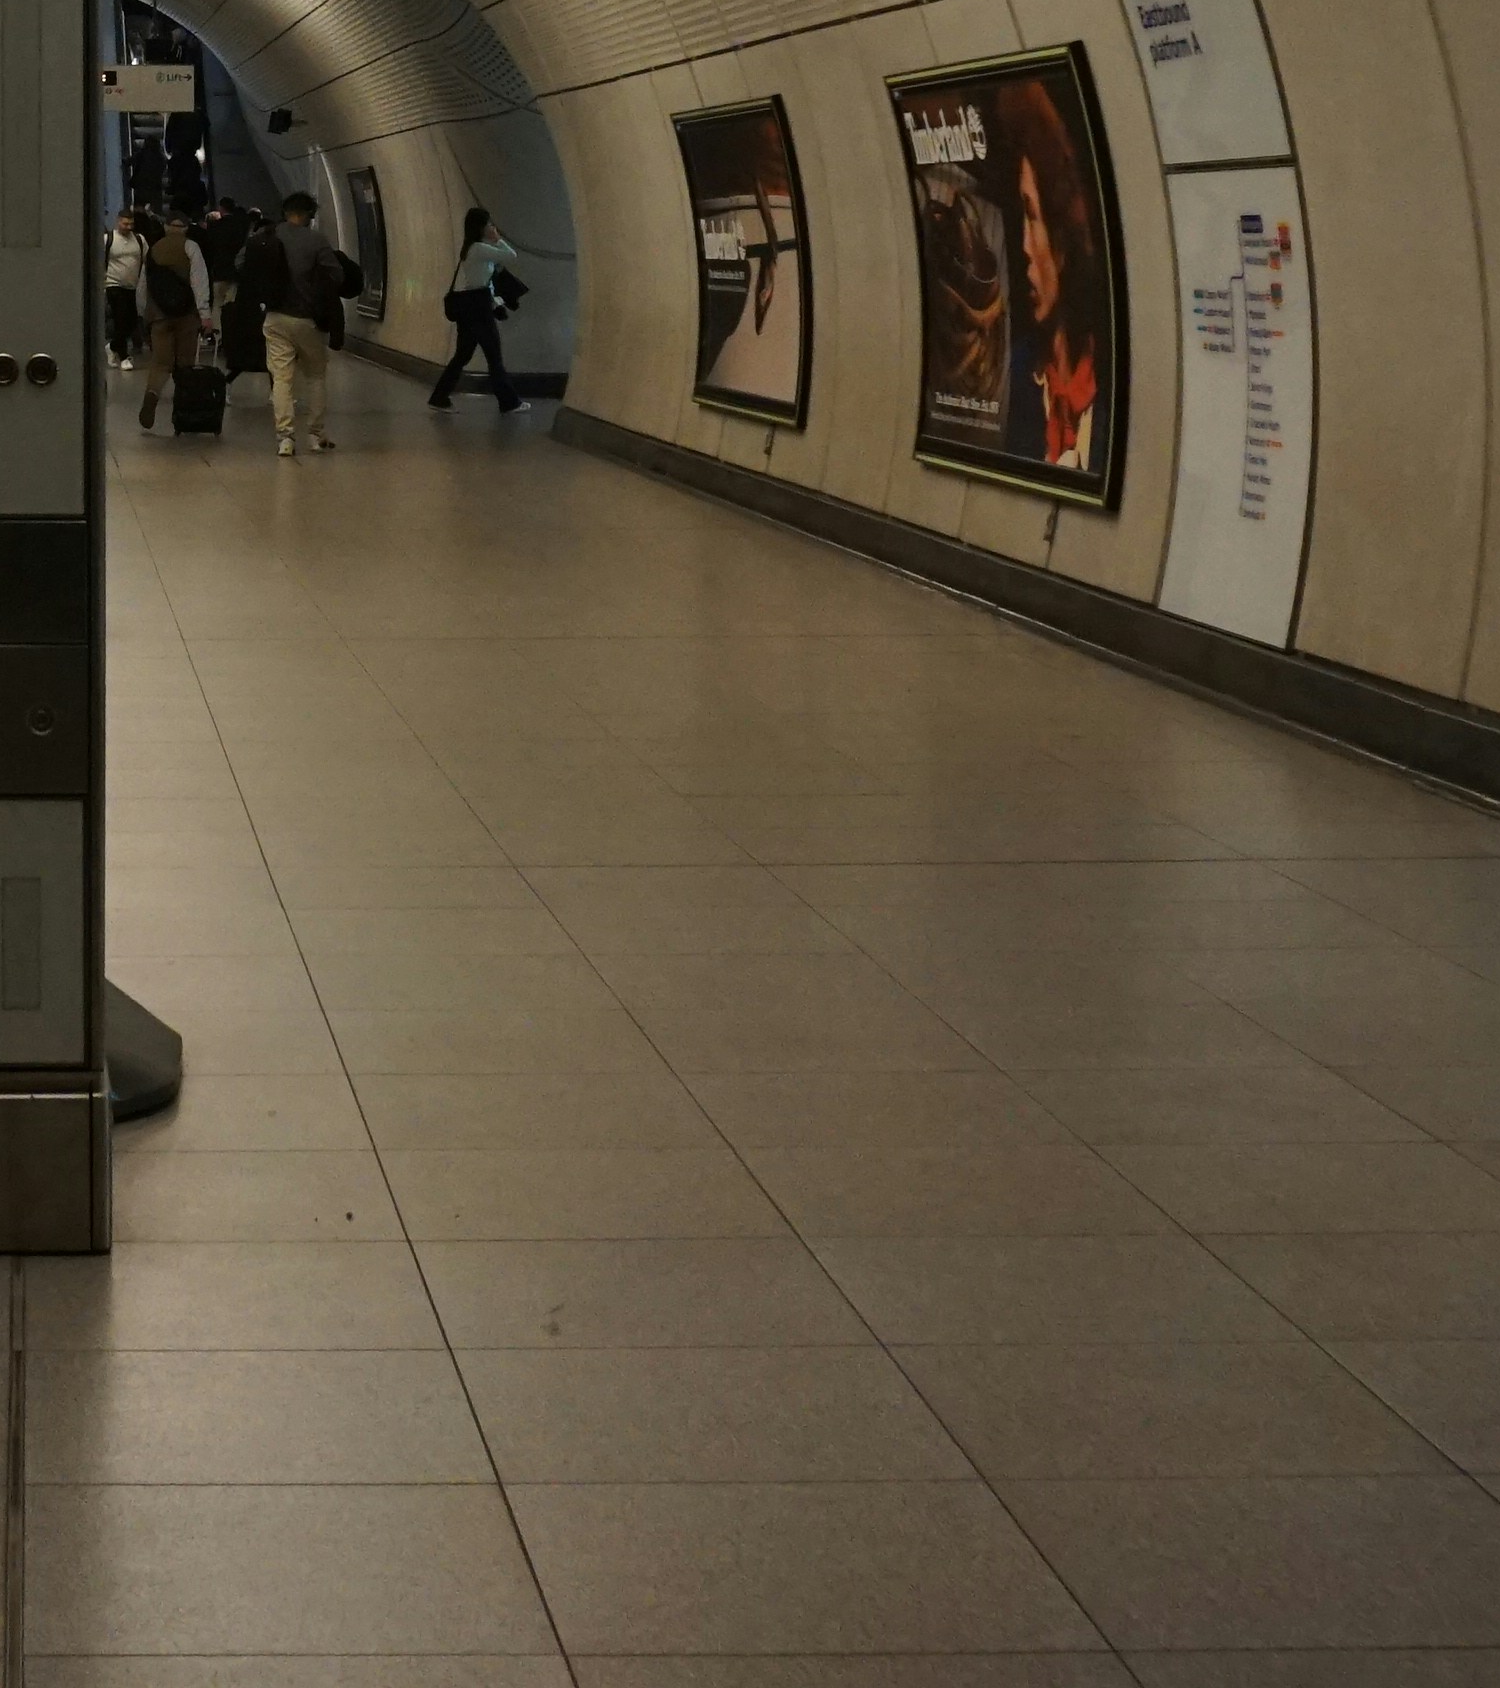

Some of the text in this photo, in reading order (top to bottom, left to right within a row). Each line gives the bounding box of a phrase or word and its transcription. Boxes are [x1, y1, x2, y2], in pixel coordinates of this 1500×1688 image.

[1149, 34, 1193, 69] platform
[166, 73, 182, 82] Lift
[903, 104, 974, 165] Timberland
